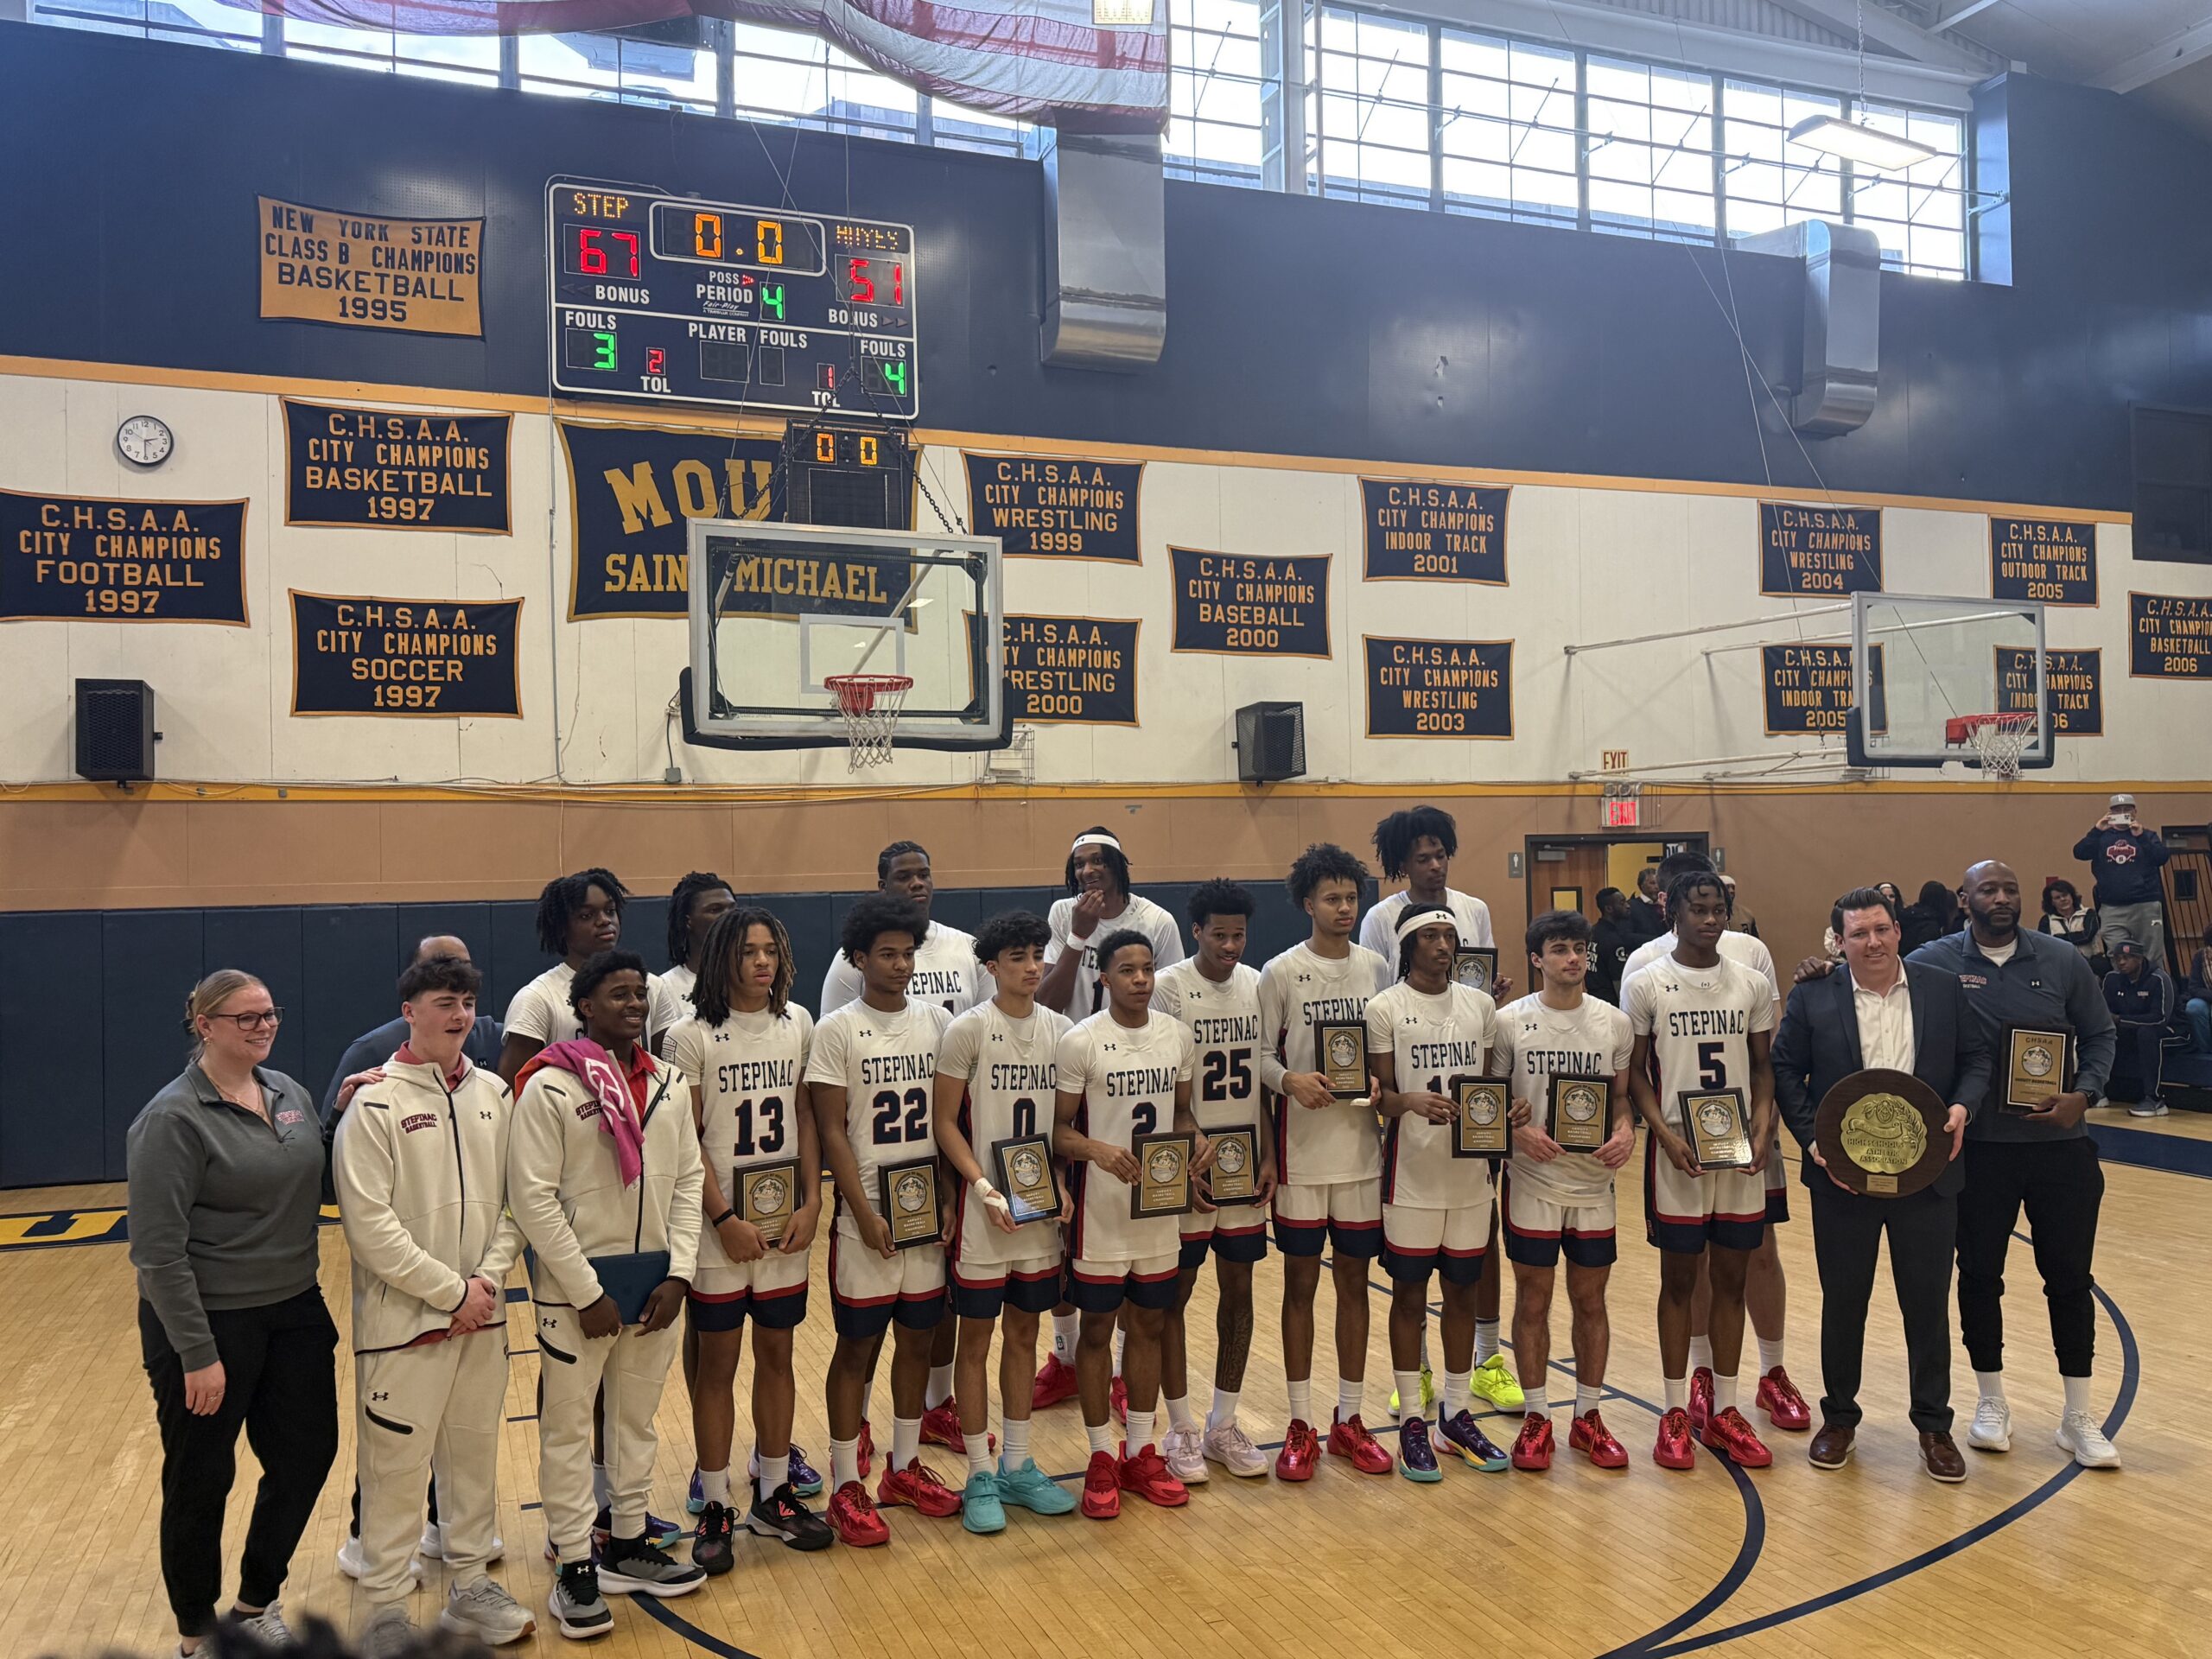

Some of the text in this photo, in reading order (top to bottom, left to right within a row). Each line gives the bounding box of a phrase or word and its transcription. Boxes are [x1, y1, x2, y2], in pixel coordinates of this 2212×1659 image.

[574, 192, 629, 219] STEP
[272, 206, 470, 248] NEW YORK STATE
[265, 233, 476, 275] CLASS B CHAMPIONS
[580, 229, 638, 277] 67
[277, 263, 465, 302] BASKETBALL
[709, 270, 739, 284] POSS
[850, 258, 902, 305] 51
[595, 285, 650, 304] BONUS
[696, 283, 753, 303] PERIOD
[763, 286, 782, 319] 4
[340, 296, 407, 322] 1995
[703, 301, 739, 311] Fair-Play
[829, 308, 878, 327] BONUS
[565, 310, 617, 330] FOULS
[689, 322, 808, 348] PLAYER FOULS
[593, 333, 614, 369] 3
[649, 349, 664, 373] 2
[861, 340, 906, 358] FOULS
[640, 376, 671, 393] TOL
[828, 366, 834, 388] 1
[885, 362, 905, 395] 4
[811, 391, 841, 408] TOL
[328, 413, 469, 442] C.H.S.A.A.
[308, 437, 489, 469] CITY CHAMPIONS
[306, 467, 493, 497] BASKETBALL
[997, 461, 1111, 486] C.H.S.A.A.
[367, 496, 435, 521] 1997
[603, 459, 772, 535] MOU
[985, 484, 1124, 510] CITY CHAMPIONS
[1389, 486, 1483, 510] C.H.S.A.A.
[41, 504, 200, 532] C.H.S.A.A.
[993, 507, 1117, 531] WRESTLING
[1378, 508, 1494, 532] CITY CHAMPIONS
[1783, 510, 1859, 531] C.H.S.A.A.
[19, 530, 220, 559] CITY CHAMPIONS
[1030, 531, 1083, 552] 1999
[1385, 531, 1487, 554] INDOOR TRACK
[1771, 530, 1871, 550] CITY CHAMPIONS
[2010, 524, 2077, 543] C.H.S.A.A.
[1414, 554, 1458, 574] 2001
[1790, 551, 1854, 570] WRESTLING
[2001, 543, 2087, 563] CITY CHAMPIONS
[36, 560, 204, 587] FOOTBALL
[605, 553, 887, 604] SAIN MICHAEL
[1200, 557, 1302, 582] C.H.S.A.A.
[1802, 572, 1843, 590] 2004
[2001, 562, 2088, 581] OUTDOOR TRACK
[85, 589, 160, 613] 1997
[1189, 579, 1314, 604] CITY CHAMPIONS
[2028, 582, 2063, 600] 2005
[337, 605, 476, 630] C.H.S.A.A.
[1199, 603, 1305, 626] BASEBALL
[2147, 600, 2212, 617] C.H.S.A.A.
[1226, 627, 1279, 648] 2000
[2139, 618, 2212, 636] CITY CHAMPION
[317, 629, 497, 656] CITY CHAMPIONS
[2151, 637, 2210, 654] BASKETBALL
[1037, 646, 1121, 669] CHAMPIONS
[1393, 645, 1485, 666] C.H.S.A.A.
[1785, 650, 1853, 667] C.H.S.A.
[2164, 657, 2198, 672] 2006
[352, 658, 463, 682] SOCCER
[1380, 667, 1498, 688] CITY CHAMPIONS
[1774, 670, 1873, 687] CITY CHAMPIS
[2006, 672, 2093, 690] CITY HAMPIONS
[373, 685, 442, 708] 1997
[1027, 694, 1082, 715] 2000
[1402, 690, 1478, 709] WRESTLING
[1782, 690, 1853, 707] INDOOR TRA
[2011, 692, 2089, 709] INDOO TRACK
[1416, 712, 1465, 732] 2003
[1806, 710, 1847, 728] 2005
[1604, 751, 1627, 771] EXIT
[906, 970, 962, 995] EPINAC
[1194, 1014, 1258, 1044] STEPINAC
[1669, 1010, 1744, 1036] STEPINAC
[1412, 1041, 1477, 1069] STEPINAC
[1528, 1051, 1601, 1075] STEPINAC
[1698, 1041, 1726, 1090] 5
[718, 1059, 793, 1093] STEPINAC
[861, 1052, 934, 1084] STEPINAC
[991, 1064, 1056, 1090] STEPINAC
[1202, 1047, 1252, 1102] 25
[1107, 1066, 1177, 1097] STEPINAC
[401, 1113, 437, 1129] STEPINAC
[734, 1096, 785, 1156] 13
[873, 1087, 928, 1145] 22
